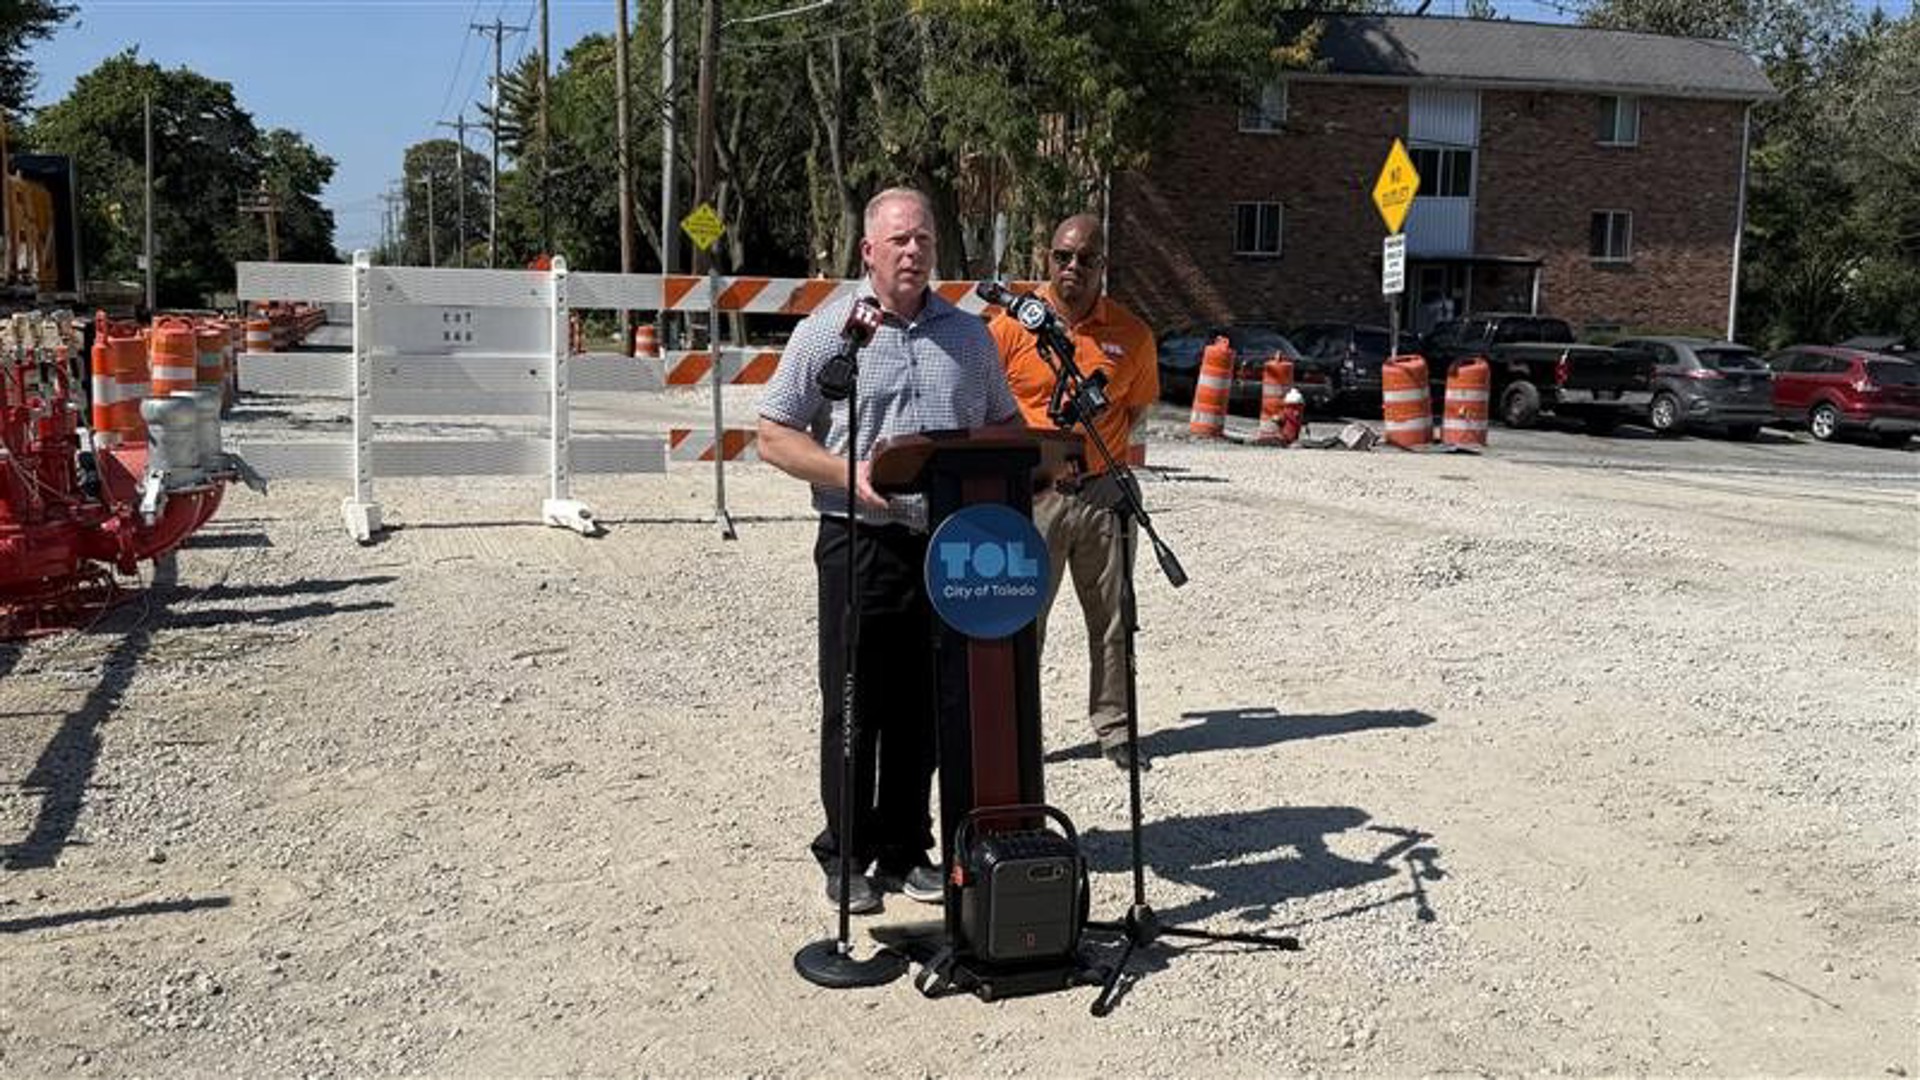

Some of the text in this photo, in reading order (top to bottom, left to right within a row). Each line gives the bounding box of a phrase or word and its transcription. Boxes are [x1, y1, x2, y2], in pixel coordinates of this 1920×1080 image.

[940, 541, 1037, 578] TOL
[943, 583, 1037, 600] City of Toledo
